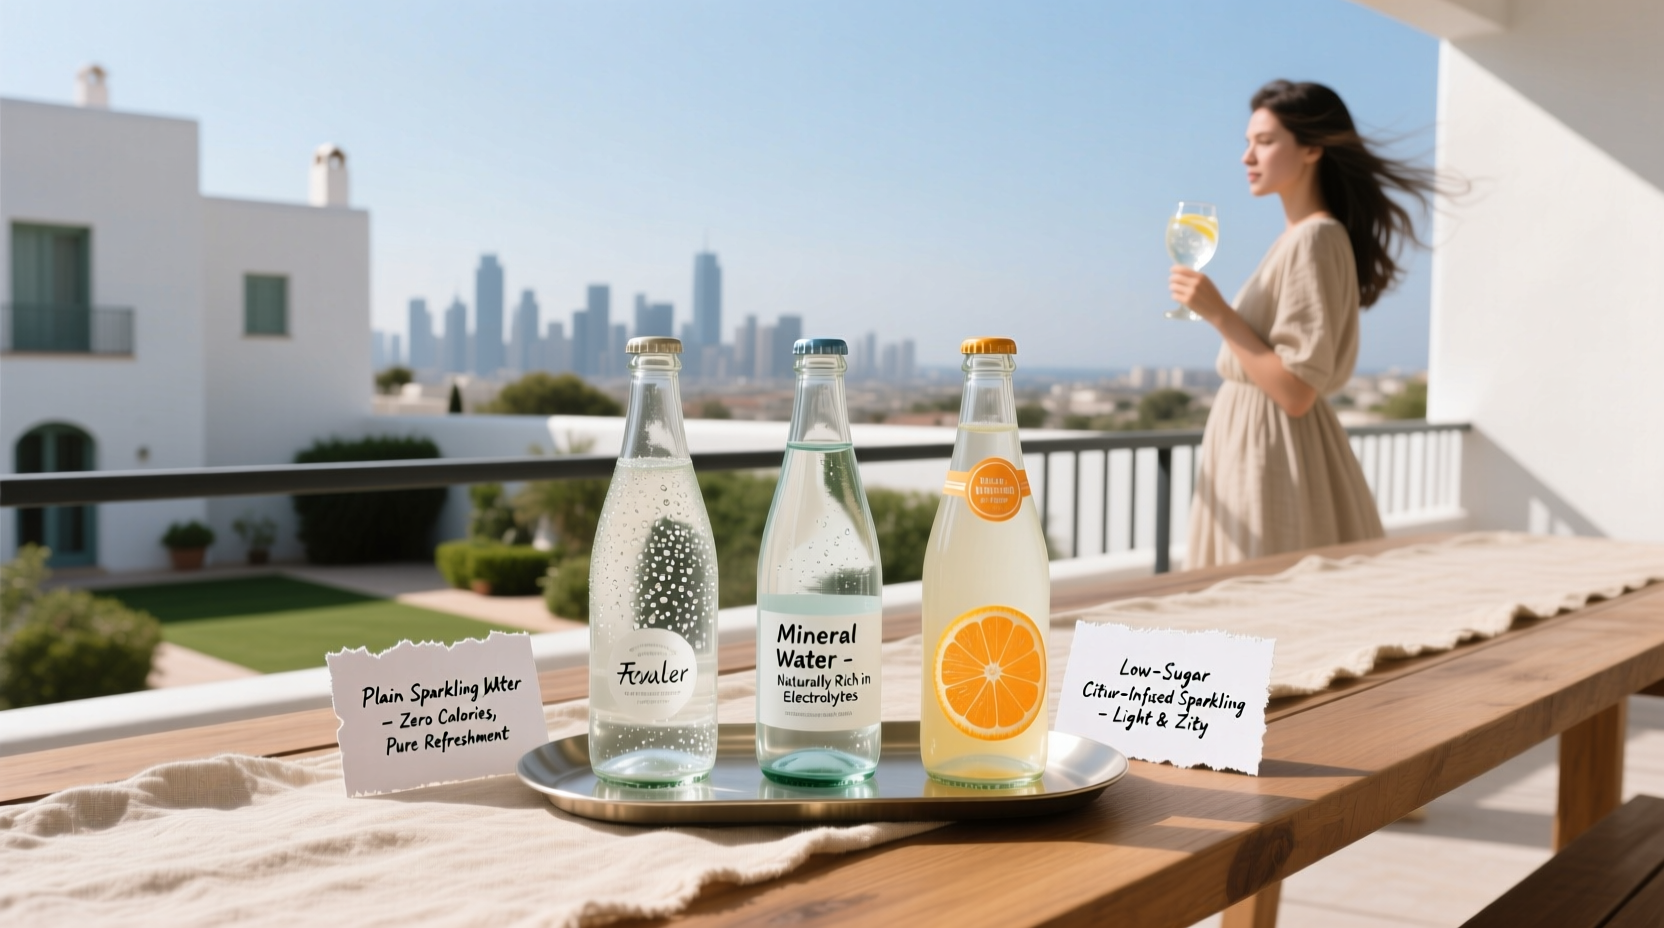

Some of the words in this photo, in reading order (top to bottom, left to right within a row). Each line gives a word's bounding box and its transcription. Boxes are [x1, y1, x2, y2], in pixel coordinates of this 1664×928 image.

[777, 622, 857, 645] Mineral
[776, 648, 838, 670] Water
[777, 673, 832, 691] Naturally
[835, 672, 859, 687] Rich
[861, 672, 871, 685] in
[1119, 658, 1211, 689] Low-Sugar
[361, 686, 404, 708] Plain
[410, 679, 479, 707] Sparkling
[783, 689, 859, 708] Electrolytes
[1177, 690, 1246, 719] Sparkling
[399, 711, 433, 729] Zero
[437, 705, 497, 725] Calories,
[1112, 705, 1154, 731] Light
[1156, 711, 1169, 728] &
[386, 736, 419, 756] Pure
[424, 725, 510, 753] Refreshment
